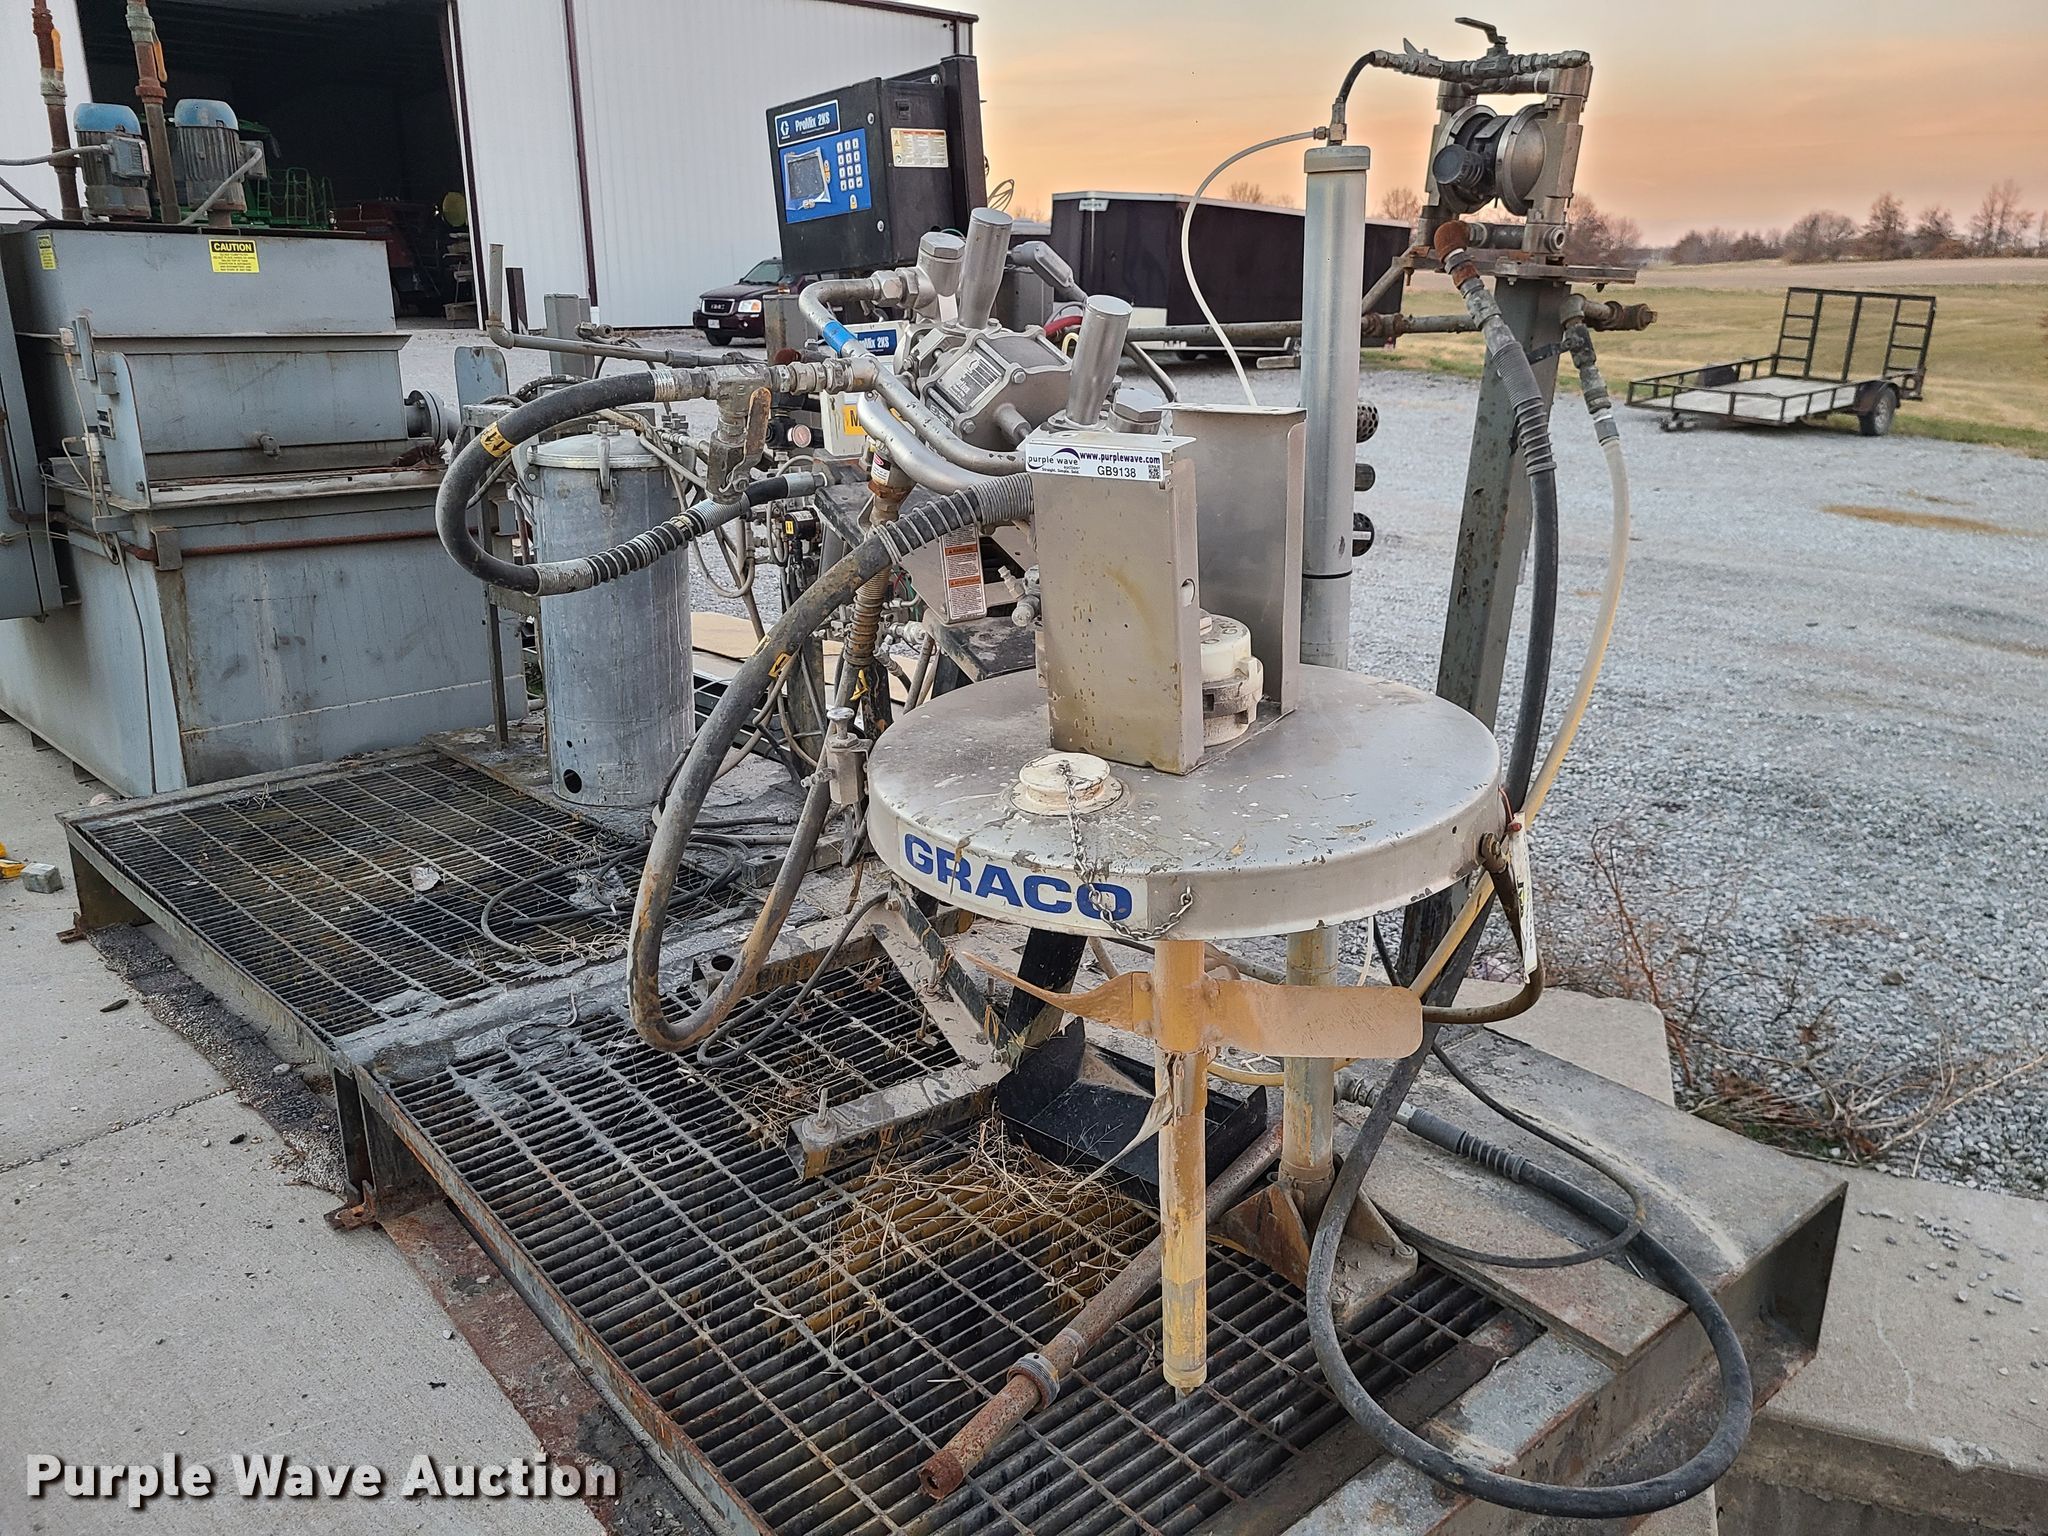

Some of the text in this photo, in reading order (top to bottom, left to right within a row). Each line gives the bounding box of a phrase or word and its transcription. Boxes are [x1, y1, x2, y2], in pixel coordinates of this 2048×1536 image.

[794, 116, 817, 133] ProMix
[213, 242, 253, 252] CAUTION
[1028, 456, 1054, 464] purple
[1079, 452, 1160, 465] www.purplewave.com
[1097, 466, 1137, 478] GB9138
[904, 833, 1133, 921] GRACO
